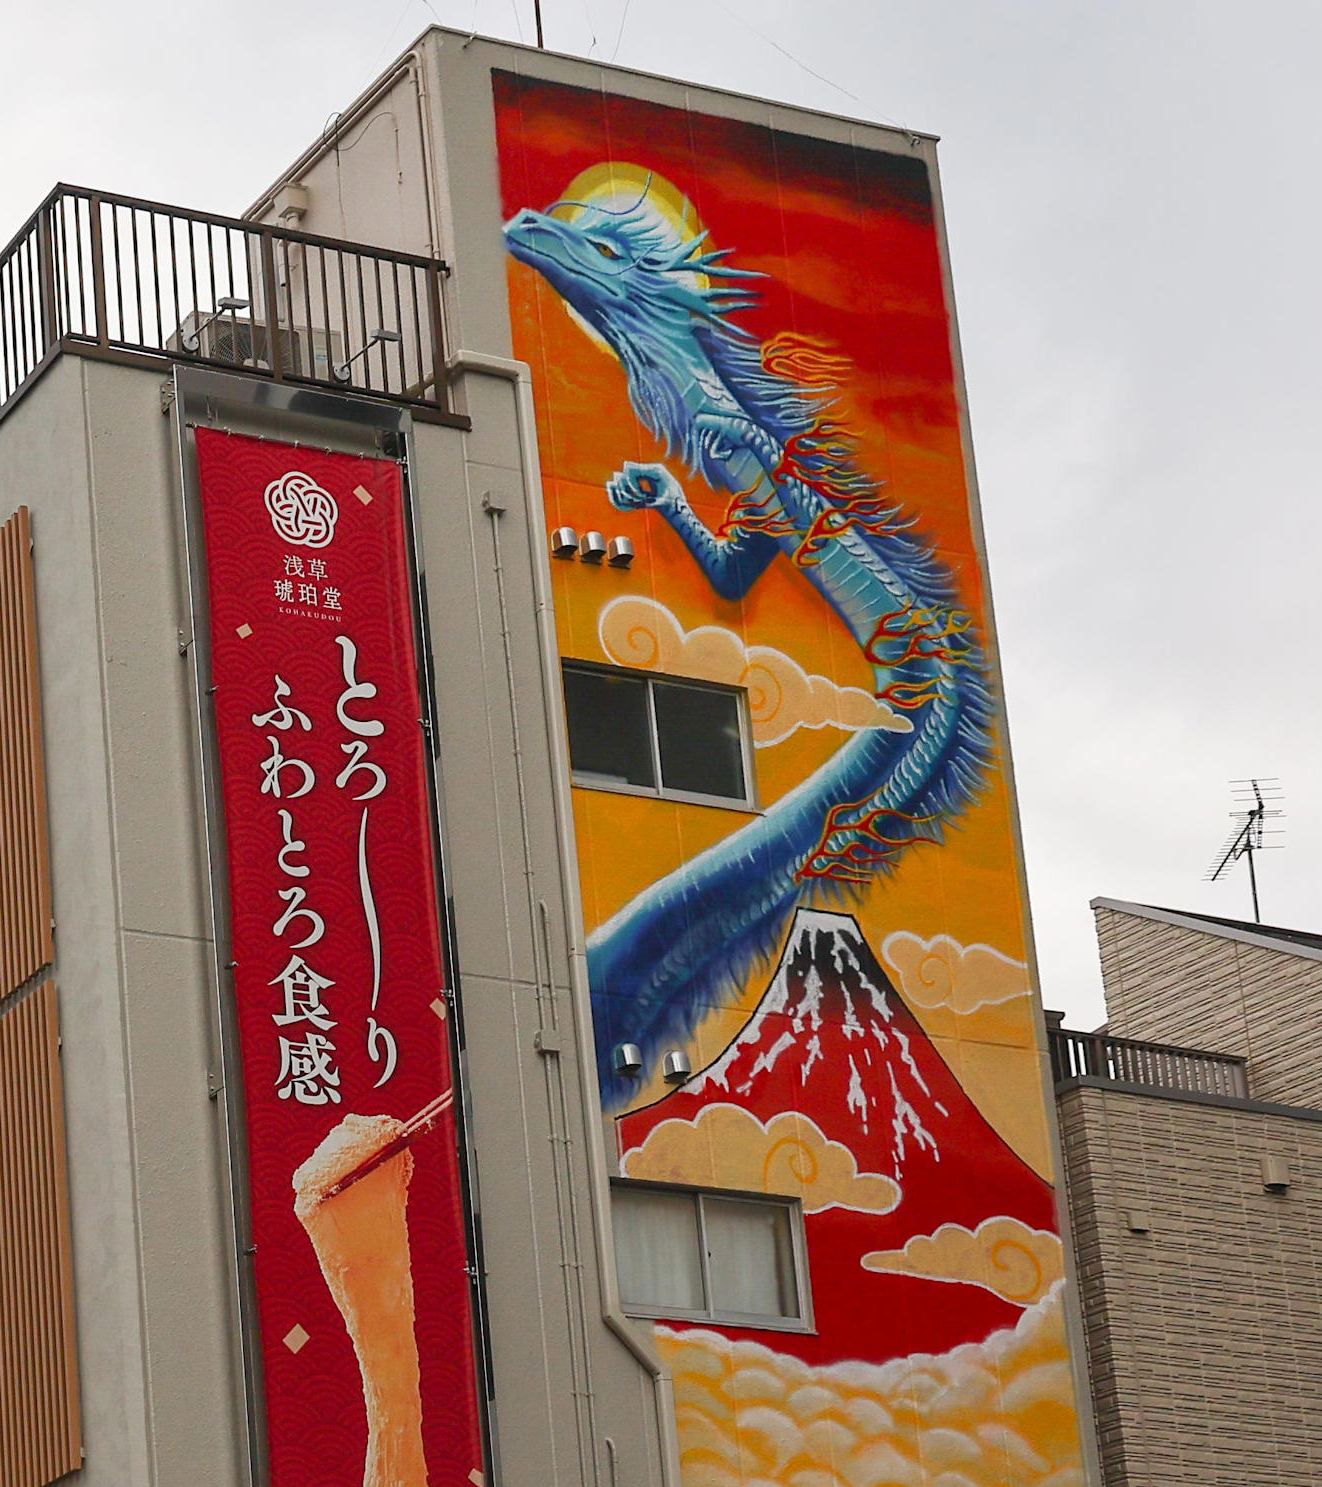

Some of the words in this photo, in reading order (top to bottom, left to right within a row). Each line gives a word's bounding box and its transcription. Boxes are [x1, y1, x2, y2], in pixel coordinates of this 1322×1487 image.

[283, 554, 328, 581] 浅草
[273, 579, 343, 611] 琥珀堂
[251, 674, 343, 1106] ふわとろ食感
